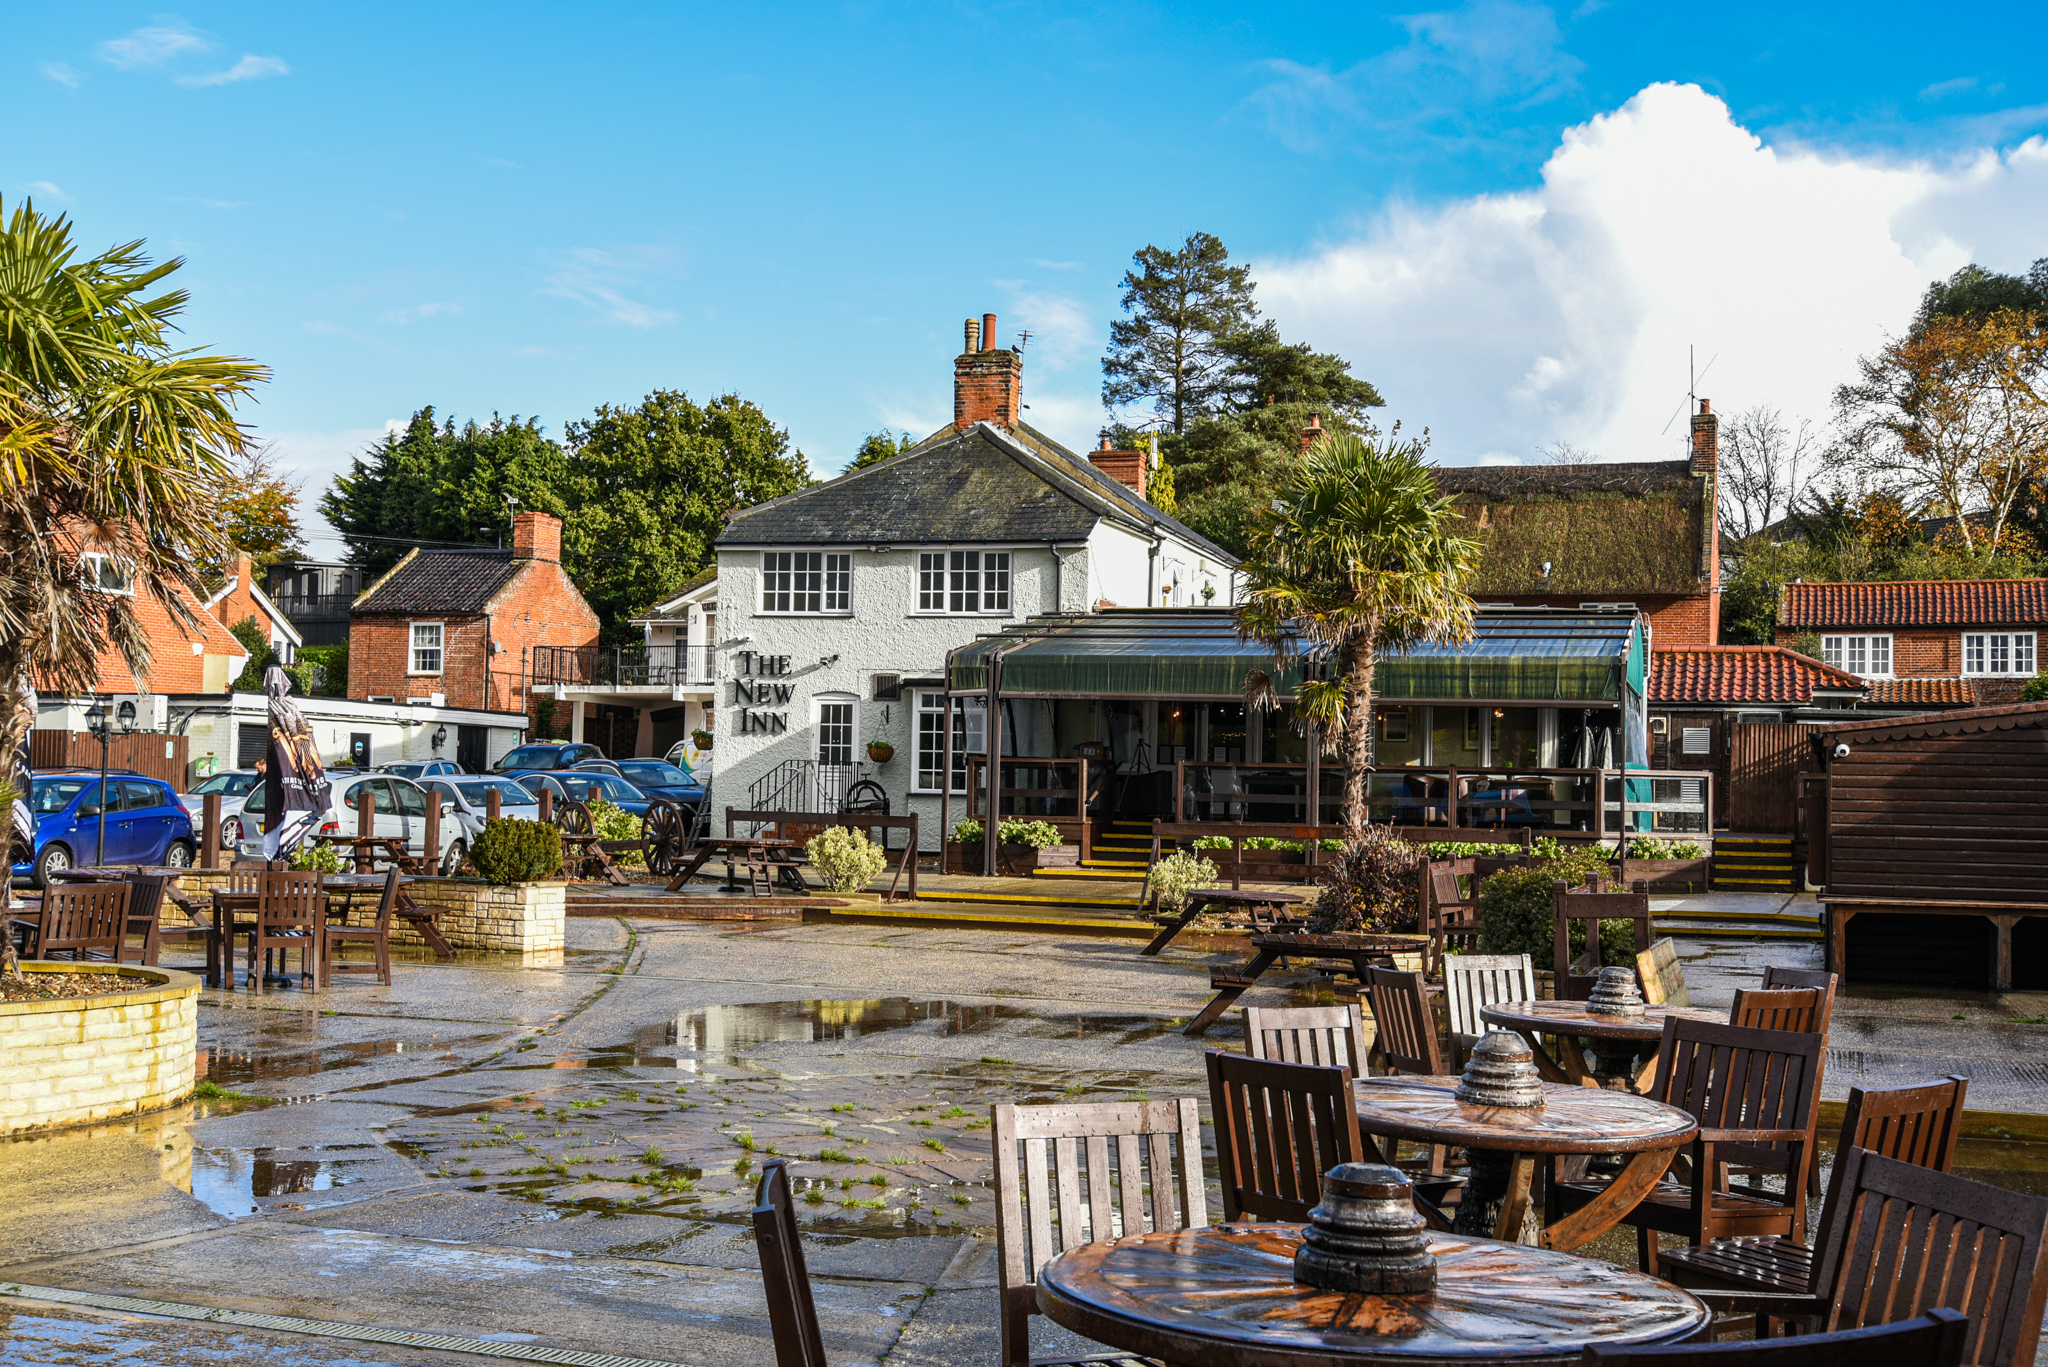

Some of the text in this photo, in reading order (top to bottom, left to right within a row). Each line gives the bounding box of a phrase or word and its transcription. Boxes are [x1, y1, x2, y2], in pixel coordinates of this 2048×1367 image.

[738, 650, 792, 675] THE
[733, 678, 797, 704] NEW
[740, 707, 788, 732] INN
